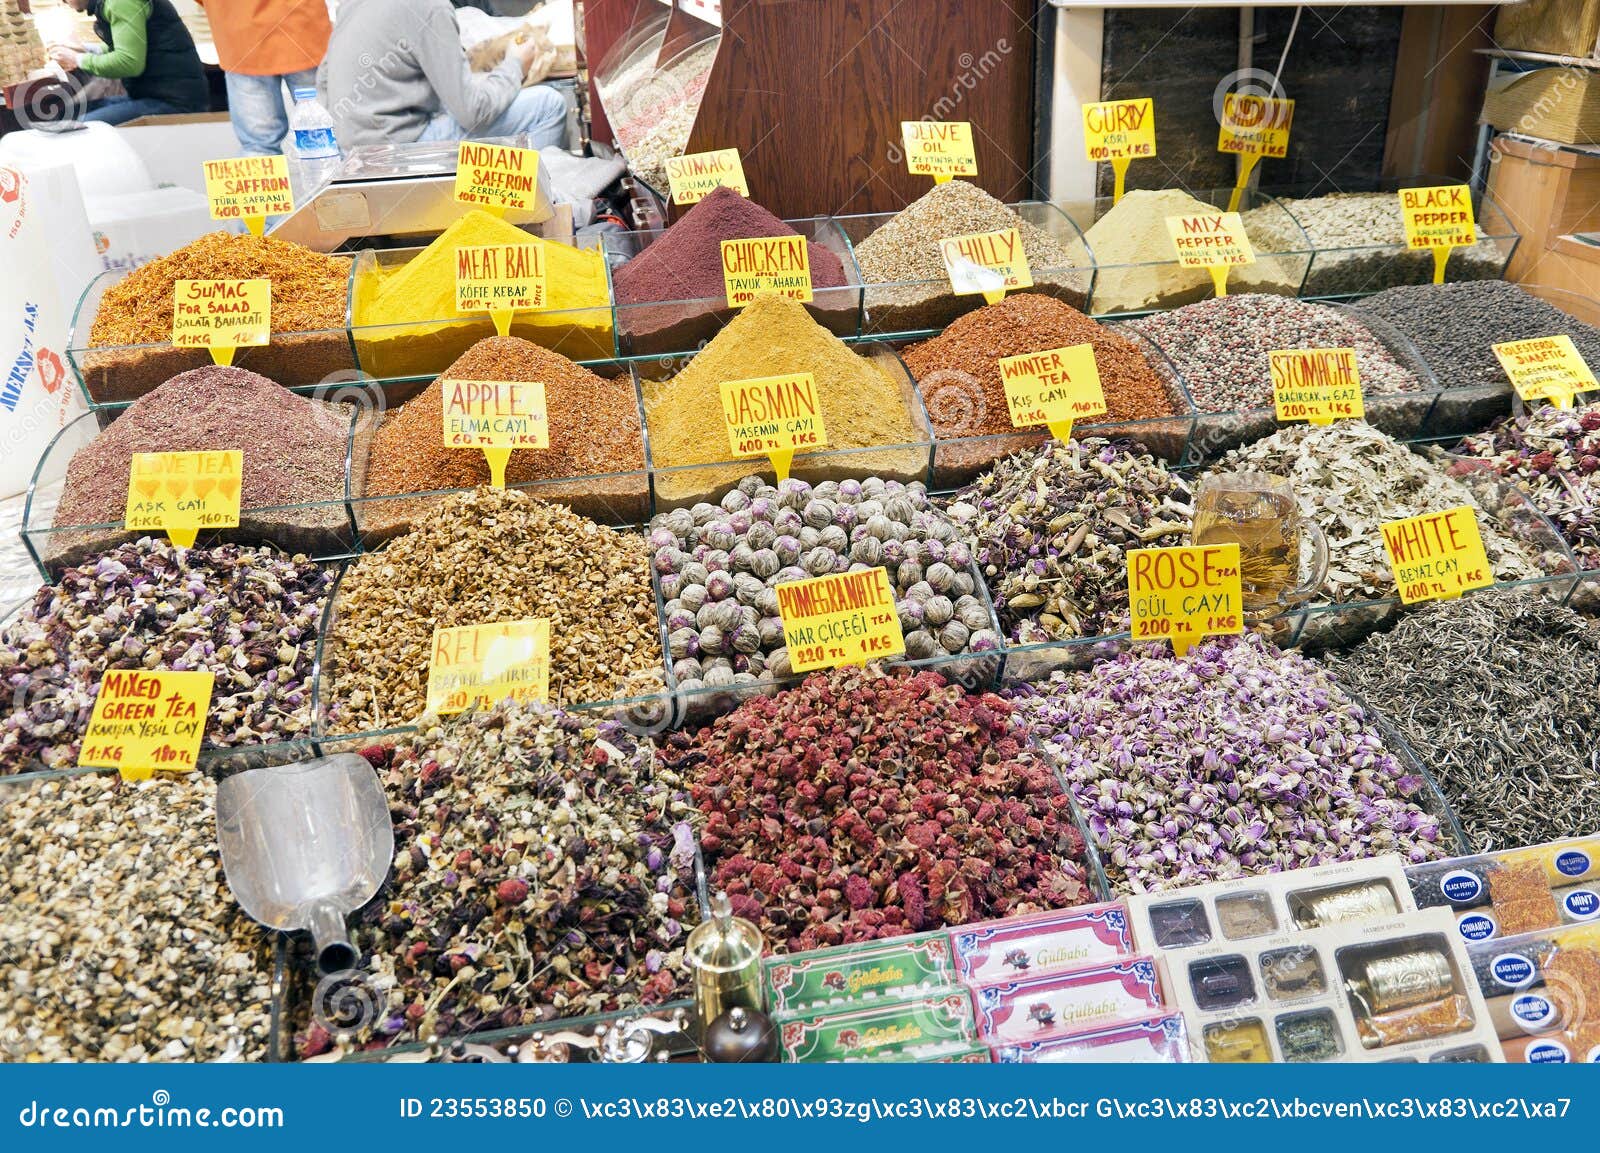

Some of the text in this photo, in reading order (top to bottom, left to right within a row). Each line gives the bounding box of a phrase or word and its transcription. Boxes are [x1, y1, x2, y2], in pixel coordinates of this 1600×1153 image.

[923, 142, 947, 152] OIL
[1090, 146, 1109, 159] 100
[1223, 140, 1244, 151] 200
[460, 145, 523, 171] INDIAN
[668, 152, 733, 179] SUMAC
[205, 158, 274, 180] TURKISH
[224, 177, 289, 195] SAFFRON
[472, 169, 532, 192] SAFFRON
[458, 192, 525, 208] 100 TL KG
[679, 191, 694, 201] 60
[1404, 188, 1465, 209] BLACK
[215, 206, 240, 217] 400
[243, 206, 258, 214] TL
[273, 202, 291, 212] KG
[1414, 212, 1470, 226] PEPPER
[1182, 216, 1227, 233] MIX
[944, 231, 1014, 268] CHILLY
[1176, 235, 1236, 248] PEPPER
[458, 246, 543, 280] MEAT BALL
[724, 240, 804, 273] CHICKEN
[187, 282, 248, 299] SUMAC
[493, 286, 527, 297] KEBAP
[728, 278, 760, 291] TAVUK
[178, 301, 250, 314] FOR SALAD
[732, 292, 755, 303] 100
[175, 312, 262, 329] SALATA BAHARATI
[1003, 353, 1064, 379] WINTER
[1272, 352, 1356, 390] STOMACHE
[1038, 370, 1071, 386] TEA
[447, 383, 527, 416] APPLE
[726, 380, 816, 425] JASMIN
[1334, 389, 1356, 401] GAZ
[1017, 409, 1047, 423] 1:KG
[1072, 401, 1091, 413] 140
[1283, 404, 1306, 416] 200
[1336, 403, 1352, 414] KG
[787, 418, 814, 432] ÇAYI
[453, 434, 472, 444] 60
[478, 436, 493, 444] TL
[739, 439, 762, 452] 400
[767, 440, 780, 448] TL
[800, 432, 817, 444] KG
[192, 453, 233, 474] TEA
[131, 513, 235, 526] 1:KG 160 TL
[1384, 512, 1467, 565] WHITE
[1135, 549, 1238, 591] ROSE TEA
[1400, 558, 1458, 583] BEYAZ ÇAY
[1406, 582, 1429, 600] 400
[1432, 583, 1446, 593] TL
[1466, 569, 1483, 582] KG
[778, 570, 889, 621] POMEGRANATE
[1136, 593, 1230, 618] GÜL ÇAYI
[788, 627, 815, 647] NAR
[871, 612, 892, 626] TEA
[1140, 618, 1170, 636] 200
[1176, 622, 1192, 632] TL
[1217, 615, 1237, 628] KG
[798, 645, 825, 664] 220
[829, 648, 846, 658] TL
[870, 635, 892, 651] KG
[102, 673, 162, 699] MIXED
[102, 692, 195, 720] GREEN TEA
[86, 744, 192, 764] 1:KG 180 TL
[1446, 881, 1476, 891] BLACK PEPPER
[1461, 920, 1490, 934] CINNAMON
[1497, 962, 1529, 973] BLACK PEPPER
